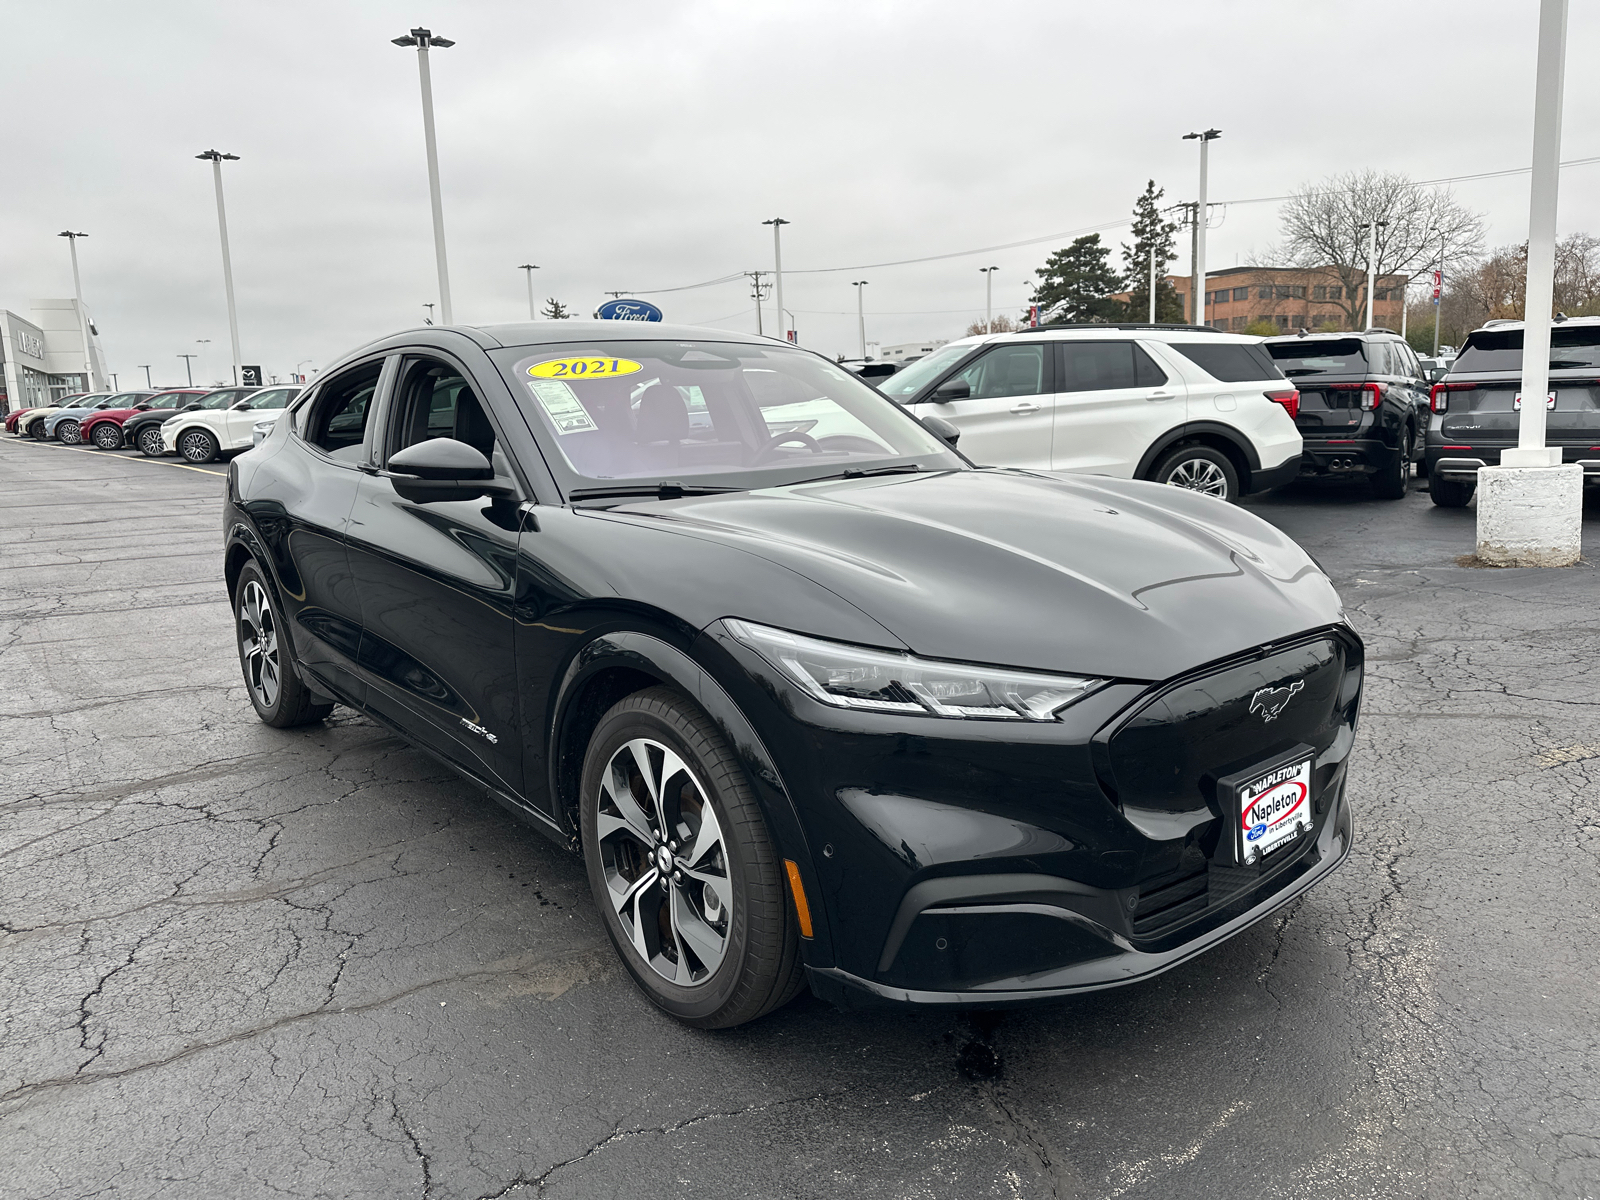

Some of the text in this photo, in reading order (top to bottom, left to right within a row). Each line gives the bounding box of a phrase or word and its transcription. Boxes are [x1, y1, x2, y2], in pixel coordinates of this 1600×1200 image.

[612, 304, 651, 321] Ford
[552, 360, 621, 377] 2021
[1251, 792, 1298, 824] Napleton
[1249, 825, 1265, 841] Ford
[1269, 827, 1275, 835] in
[1275, 811, 1303, 832] Libertyville
[1262, 830, 1298, 856] LIBERTYVILLE
